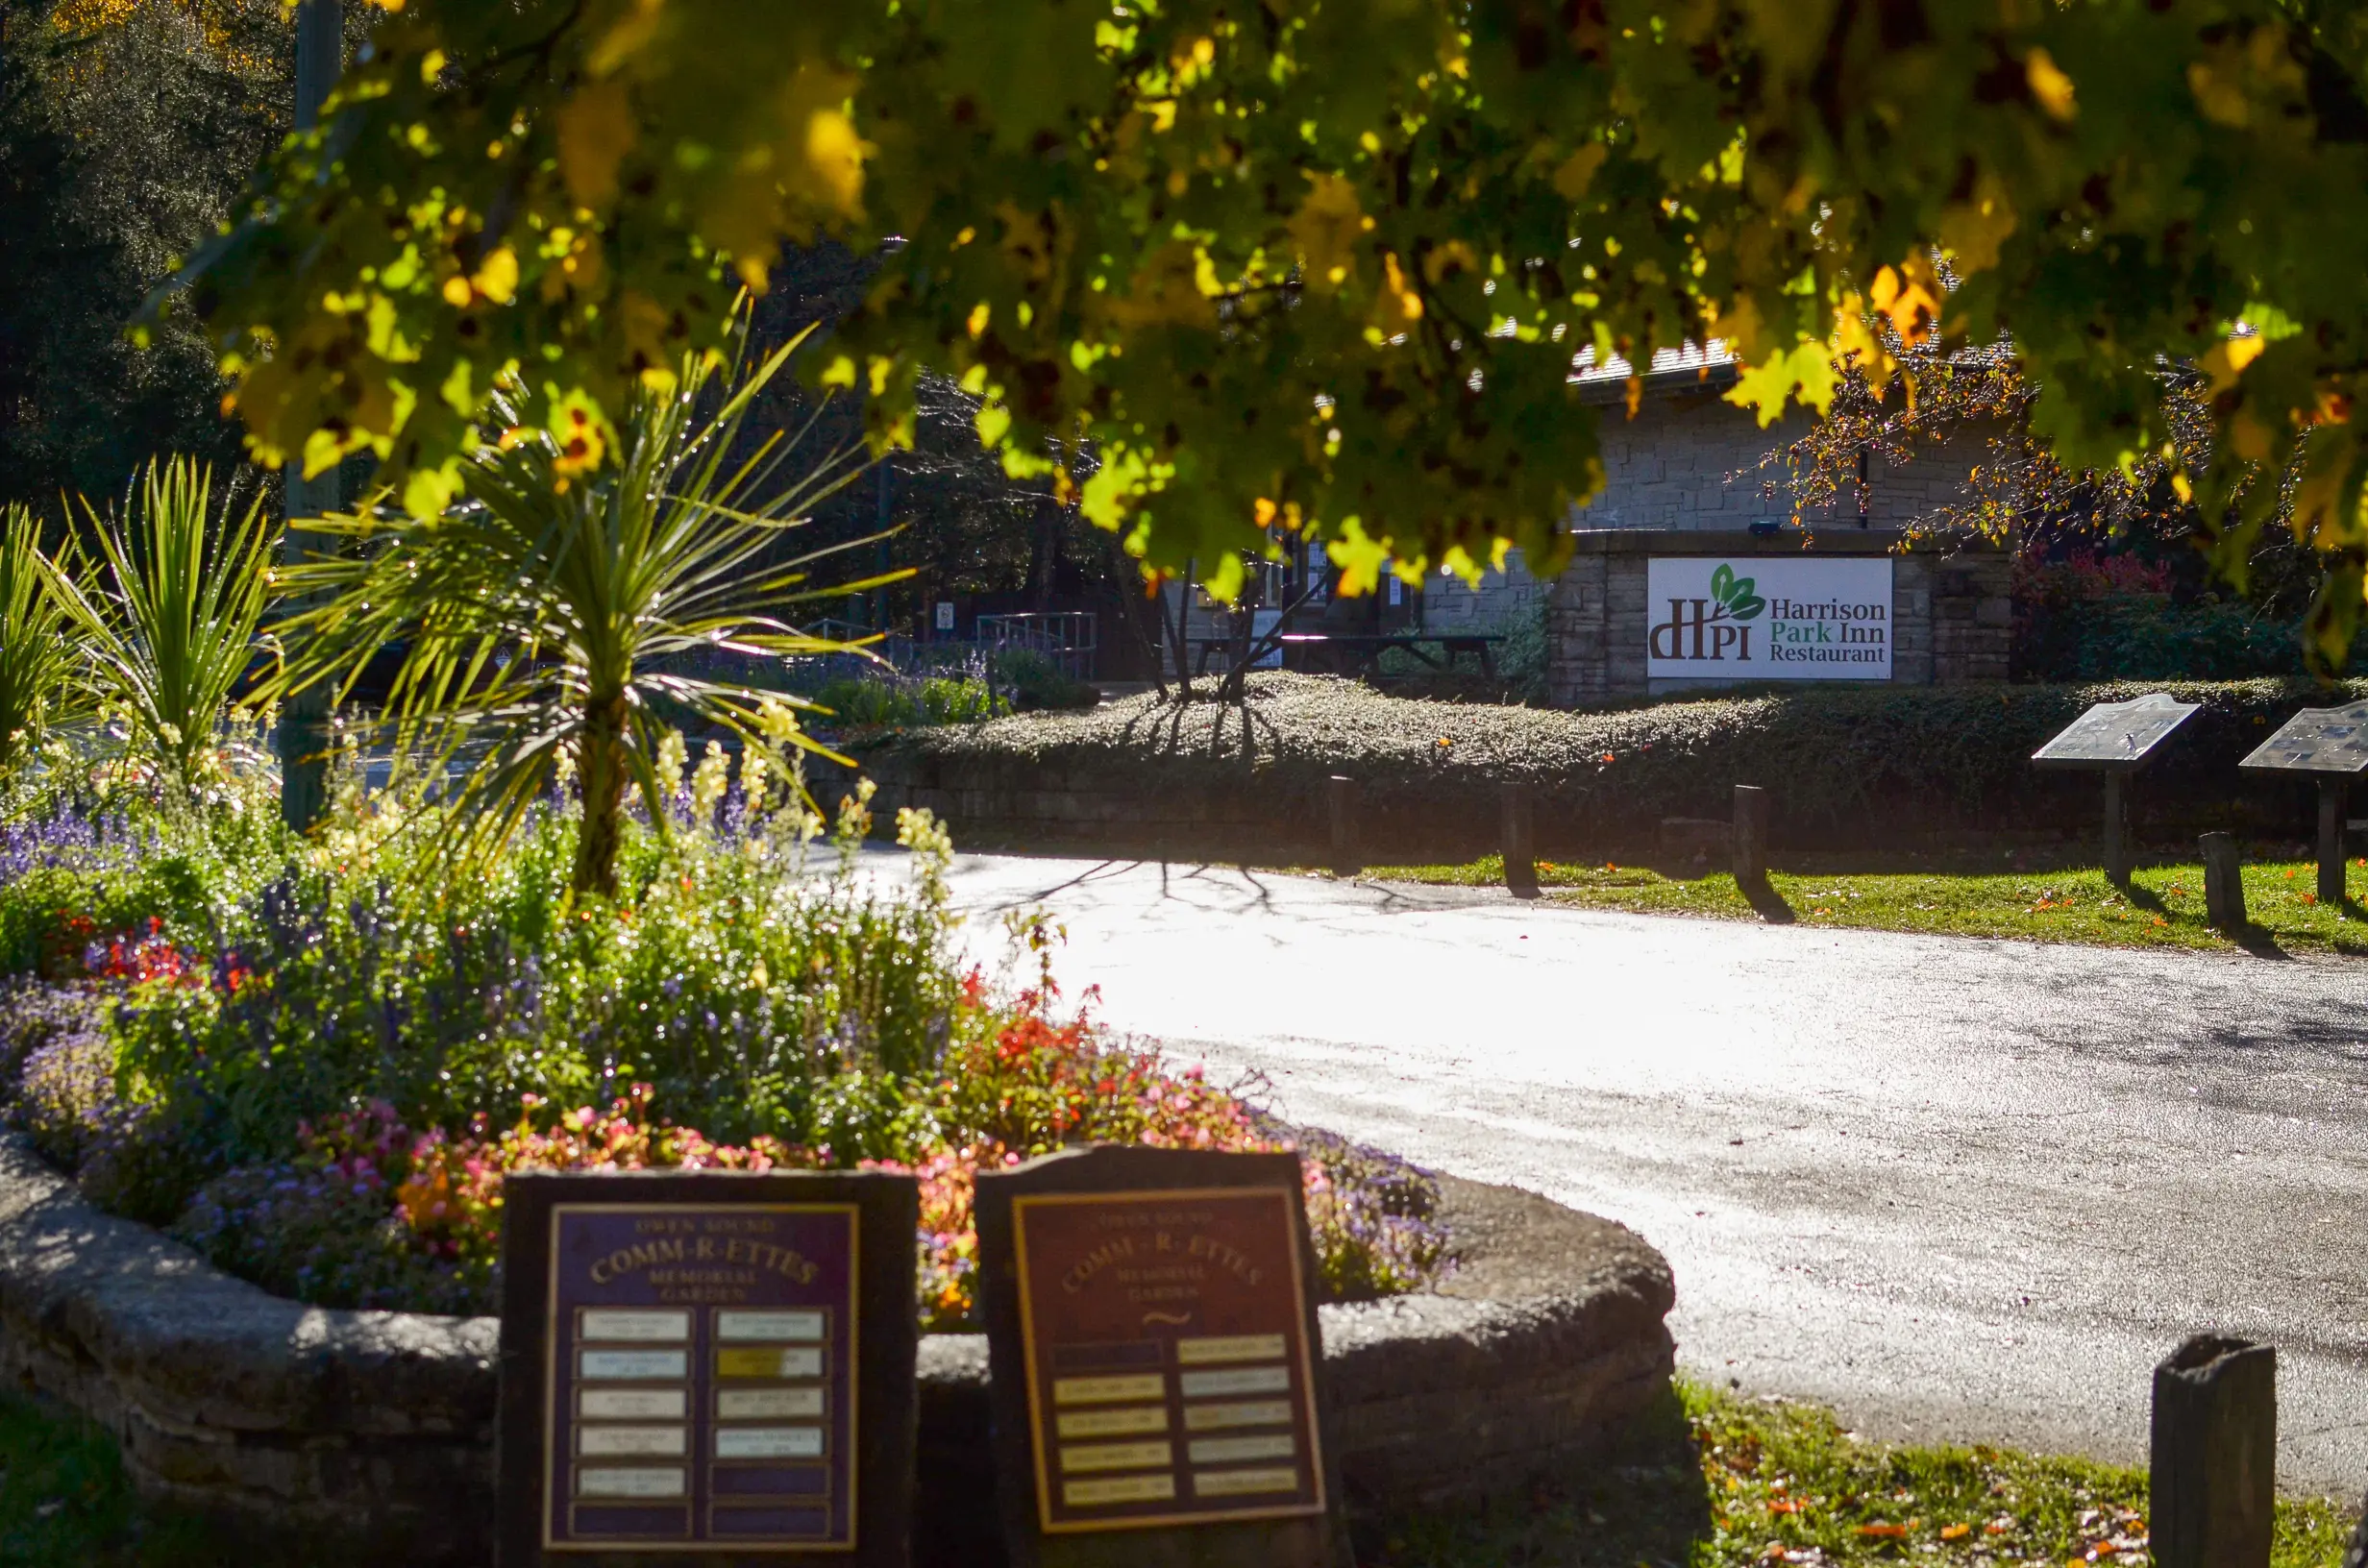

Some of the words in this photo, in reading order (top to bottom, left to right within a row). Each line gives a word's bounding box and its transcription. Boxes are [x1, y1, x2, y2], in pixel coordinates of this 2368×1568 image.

[1770, 599, 1887, 621] Harrison
[1770, 622, 1833, 643] Park
[1839, 624, 1886, 644] Inn
[1770, 645, 1886, 663] Restaurant
